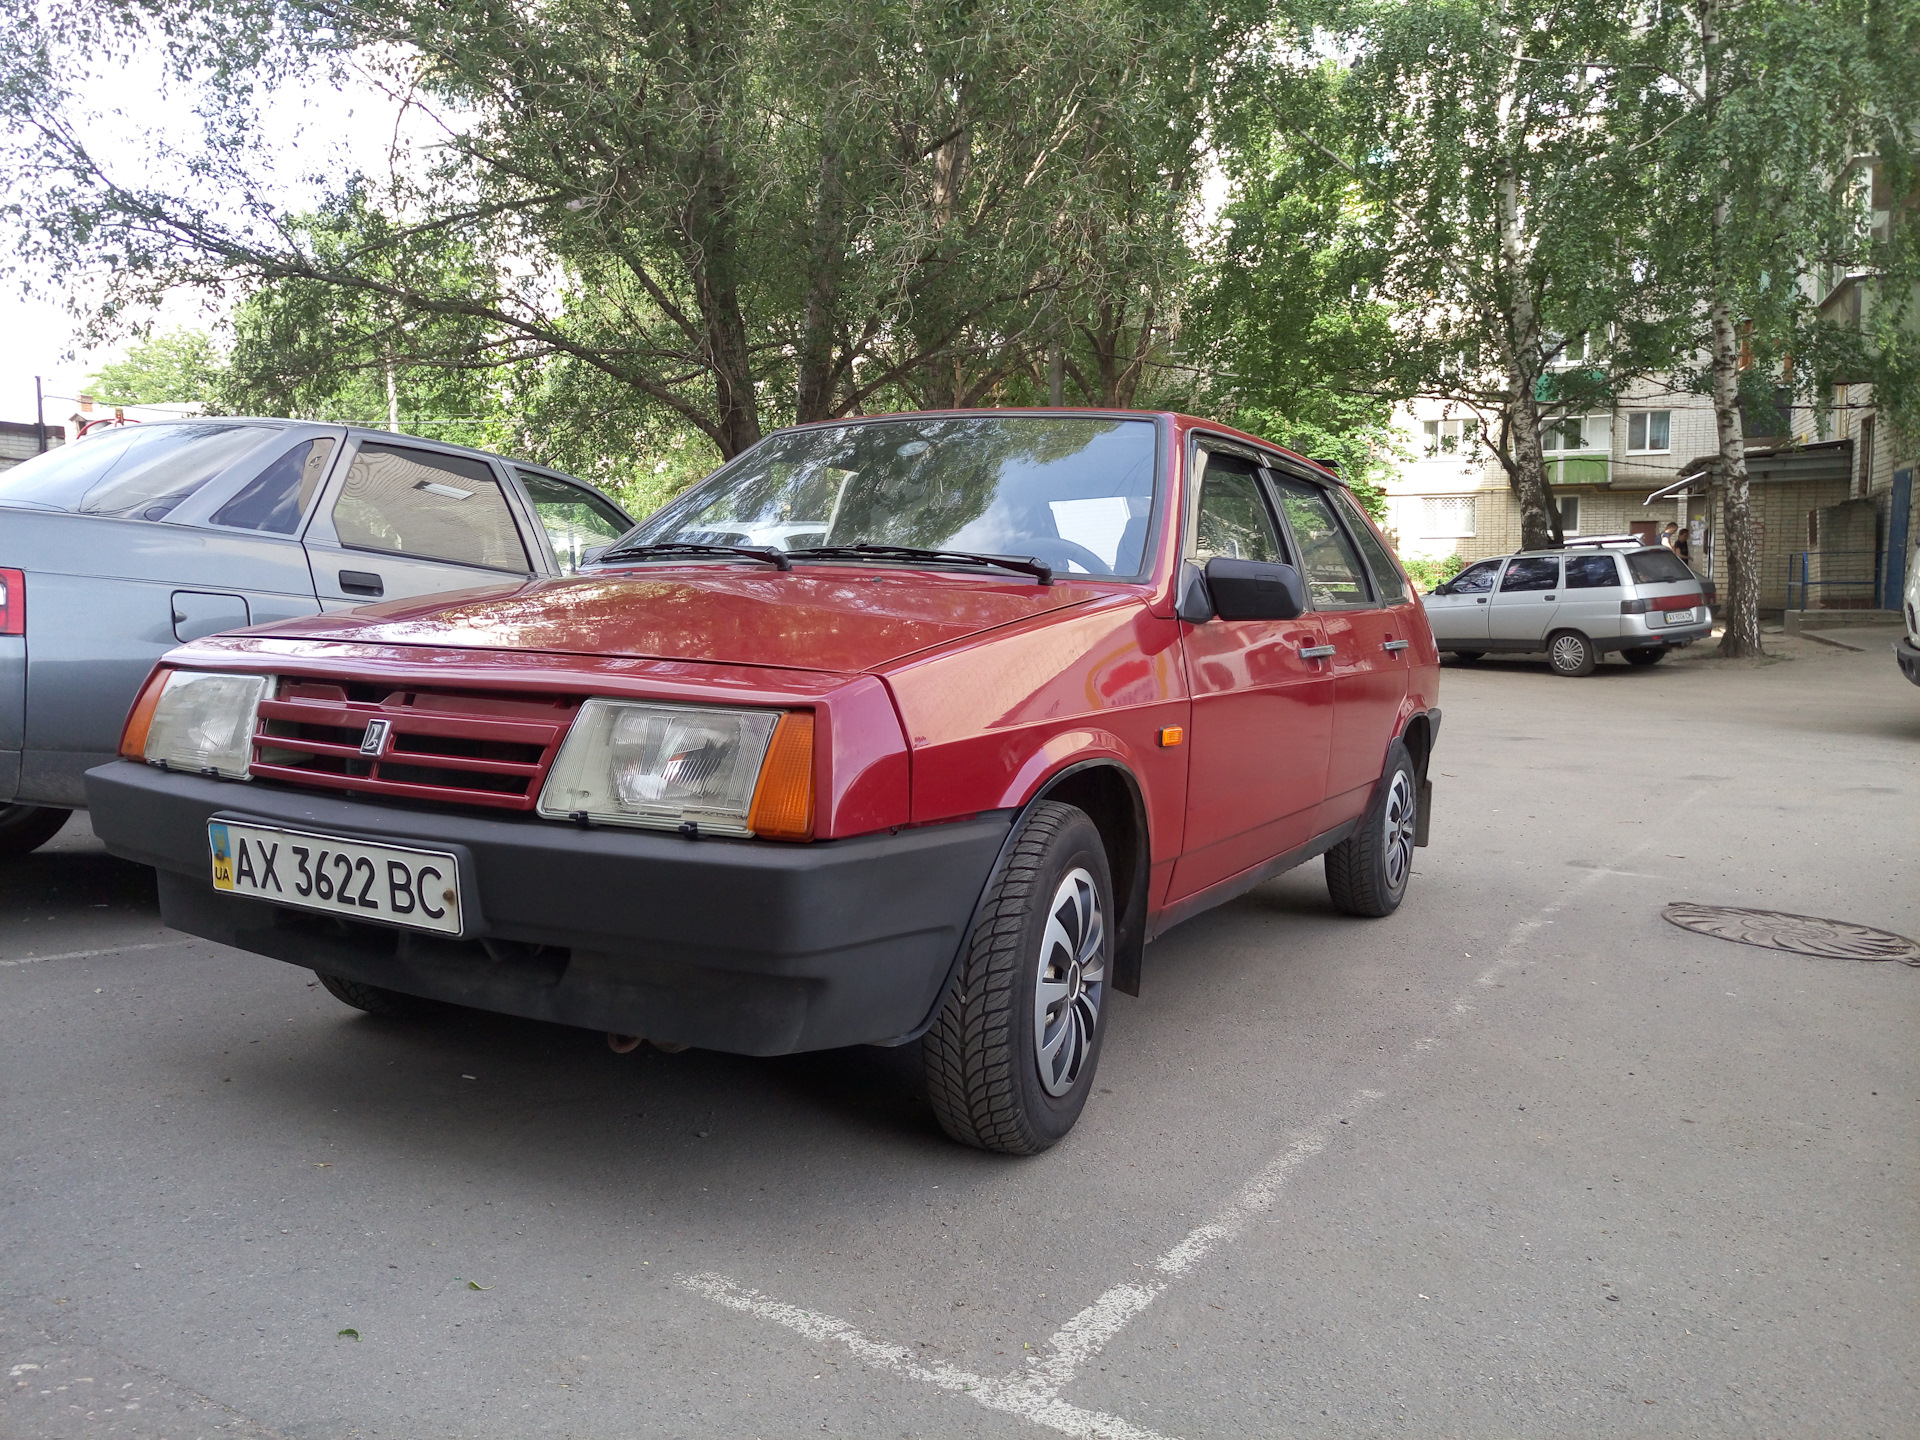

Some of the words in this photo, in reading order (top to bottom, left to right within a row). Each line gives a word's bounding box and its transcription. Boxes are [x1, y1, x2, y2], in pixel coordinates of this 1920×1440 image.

[215, 866, 230, 882] UA
[236, 837, 283, 892] AX
[292, 845, 379, 909] 3622
[387, 858, 445, 919] BC
